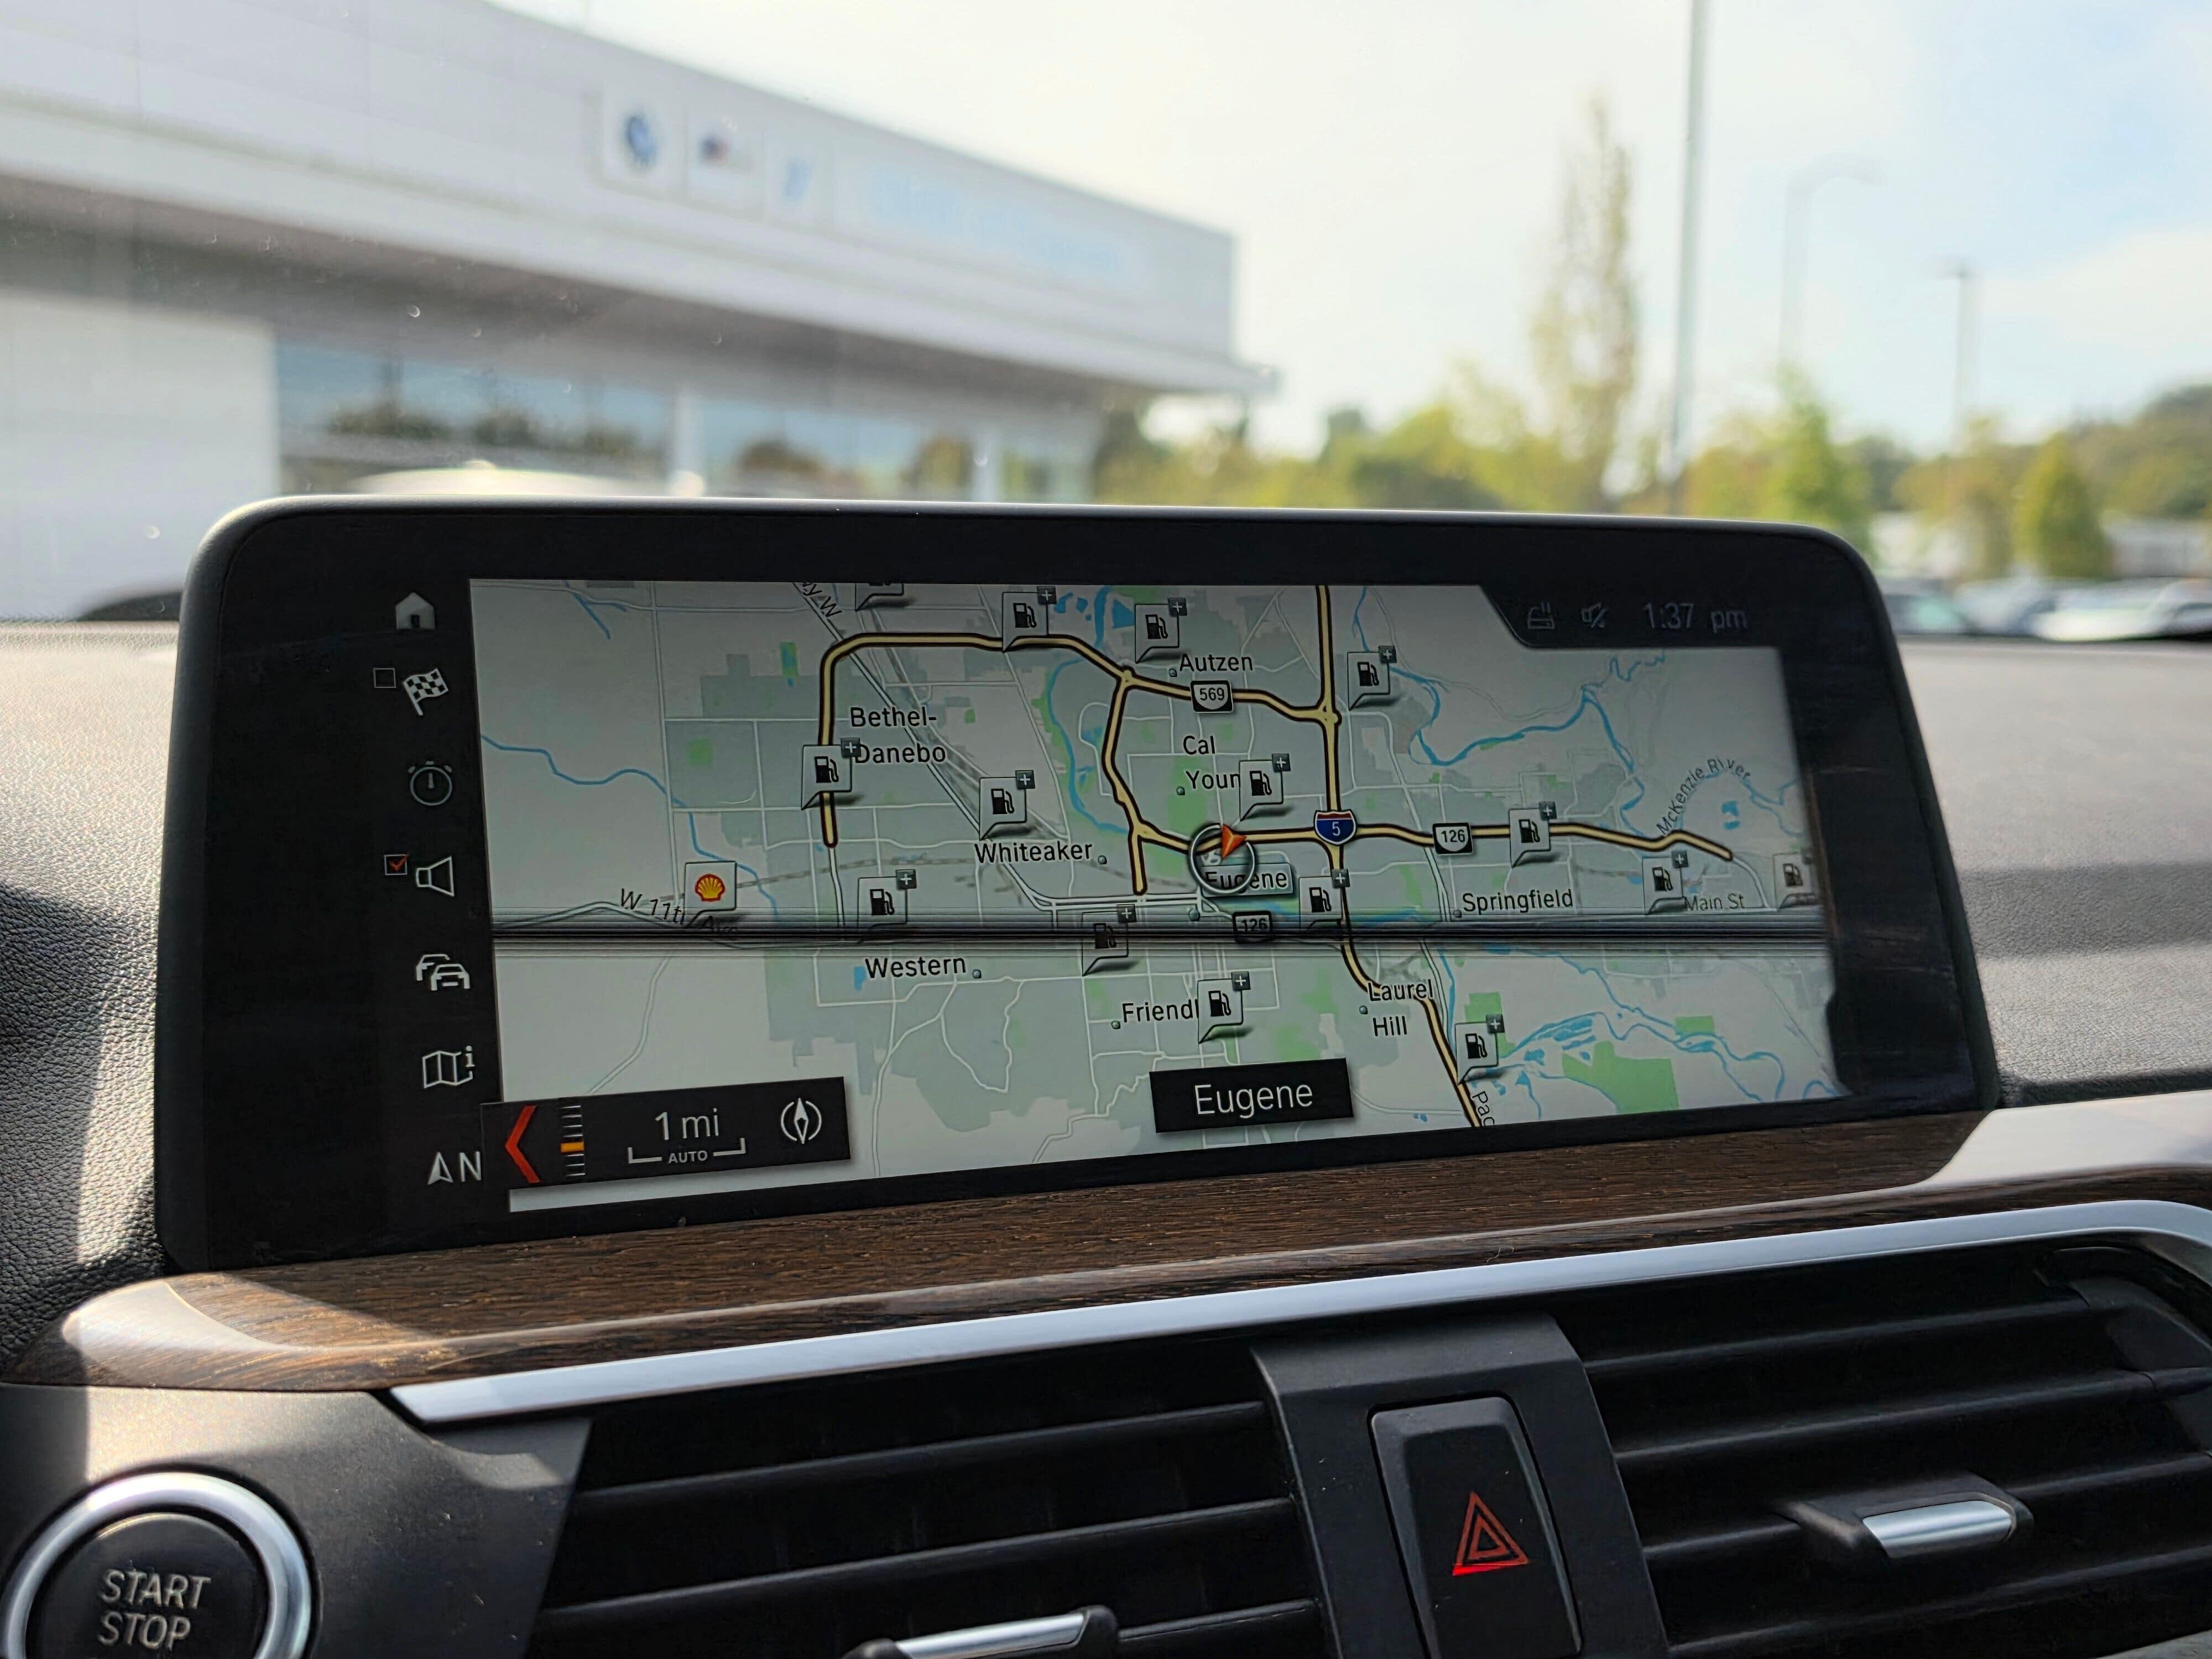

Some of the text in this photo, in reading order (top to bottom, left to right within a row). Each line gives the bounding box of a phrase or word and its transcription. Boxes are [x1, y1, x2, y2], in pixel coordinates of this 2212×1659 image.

[820, 596, 842, 617] W
[1644, 602, 1748, 633] 1:37 pm
[1180, 654, 1253, 672] Autzen
[1199, 687, 1225, 701] 569
[851, 707, 937, 728] Bethel-
[855, 744, 946, 764] Danebo
[1183, 735, 1216, 755] Cal
[1185, 770, 1240, 790] Youn
[1656, 756, 1751, 836] McKenzie River
[1332, 822, 1341, 837] 5
[1440, 829, 1467, 844] 126
[974, 842, 1093, 864] Whiteaker
[1205, 871, 1287, 894] Eugene
[621, 888, 643, 910] W
[1463, 889, 1573, 913] Springfield
[1683, 893, 1744, 911] Main St
[1241, 918, 1267, 935] 126
[865, 956, 967, 978] Western
[1368, 979, 1434, 1001] Laurel
[1122, 999, 1199, 1022] Friendl
[1373, 1015, 1408, 1037] Hill
[1194, 1083, 1313, 1119] Eugene
[655, 1108, 720, 1140] 1 mi
[460, 1150, 482, 1182] N
[668, 1150, 708, 1164] AUTO
[100, 1568, 211, 1610] START
[97, 1610, 191, 1651] STOP
